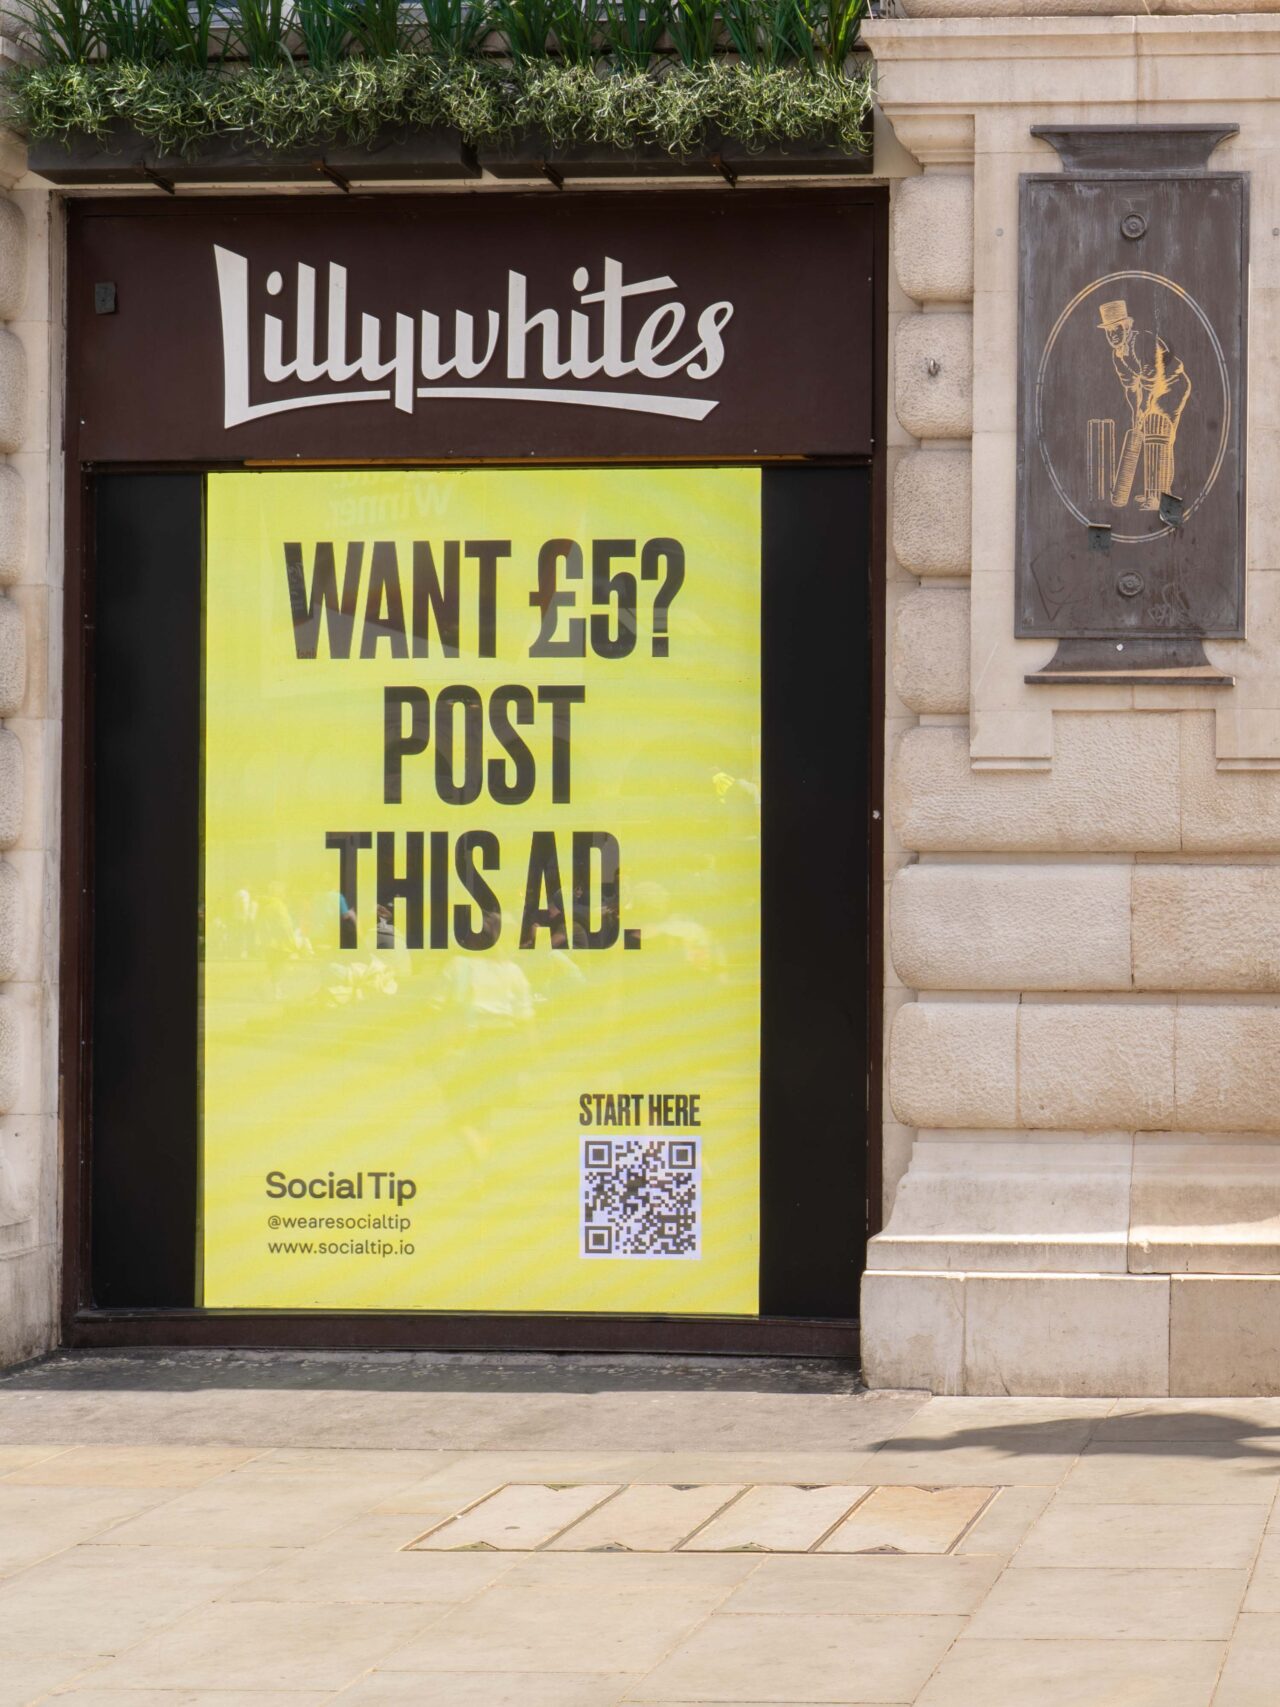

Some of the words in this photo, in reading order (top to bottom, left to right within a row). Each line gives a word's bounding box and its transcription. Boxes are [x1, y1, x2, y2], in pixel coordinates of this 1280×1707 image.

[214, 245, 733, 429] Lillywhites
[284, 540, 511, 659] WANT
[529, 538, 685, 659] £5?
[384, 685, 585, 805] POST
[326, 830, 501, 951] THIS
[519, 832, 641, 949] AD.
[580, 1094, 644, 1126] START
[649, 1095, 701, 1126] HERE
[266, 1172, 362, 1199] Social
[368, 1172, 416, 1206] Tip
[268, 1214, 410, 1232] @wearesocialtip
[268, 1240, 414, 1257] www.socialtip.io
